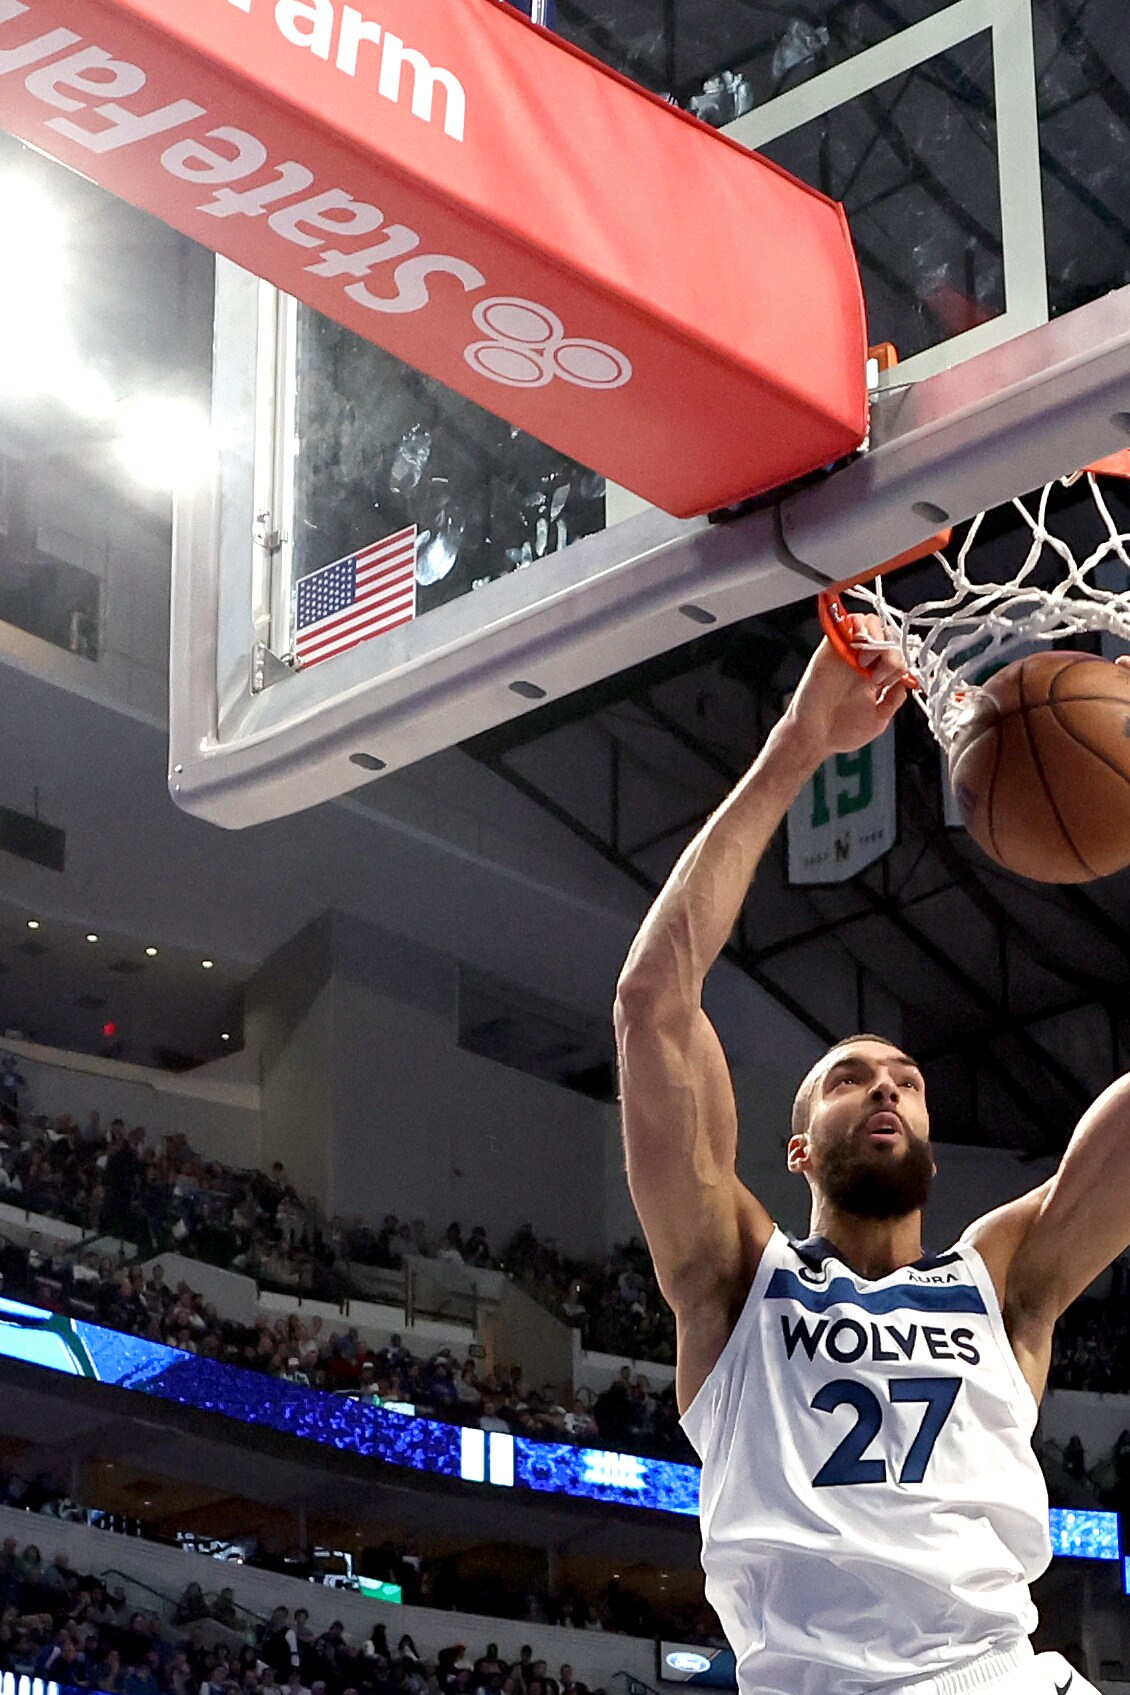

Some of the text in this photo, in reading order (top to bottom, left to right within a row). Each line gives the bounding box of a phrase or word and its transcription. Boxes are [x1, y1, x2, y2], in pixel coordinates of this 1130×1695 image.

[227, 0, 467, 143] arm
[811, 749, 873, 828] 19
[780, 1315, 981, 1366] WOLVES
[810, 1376, 963, 1488] 27
